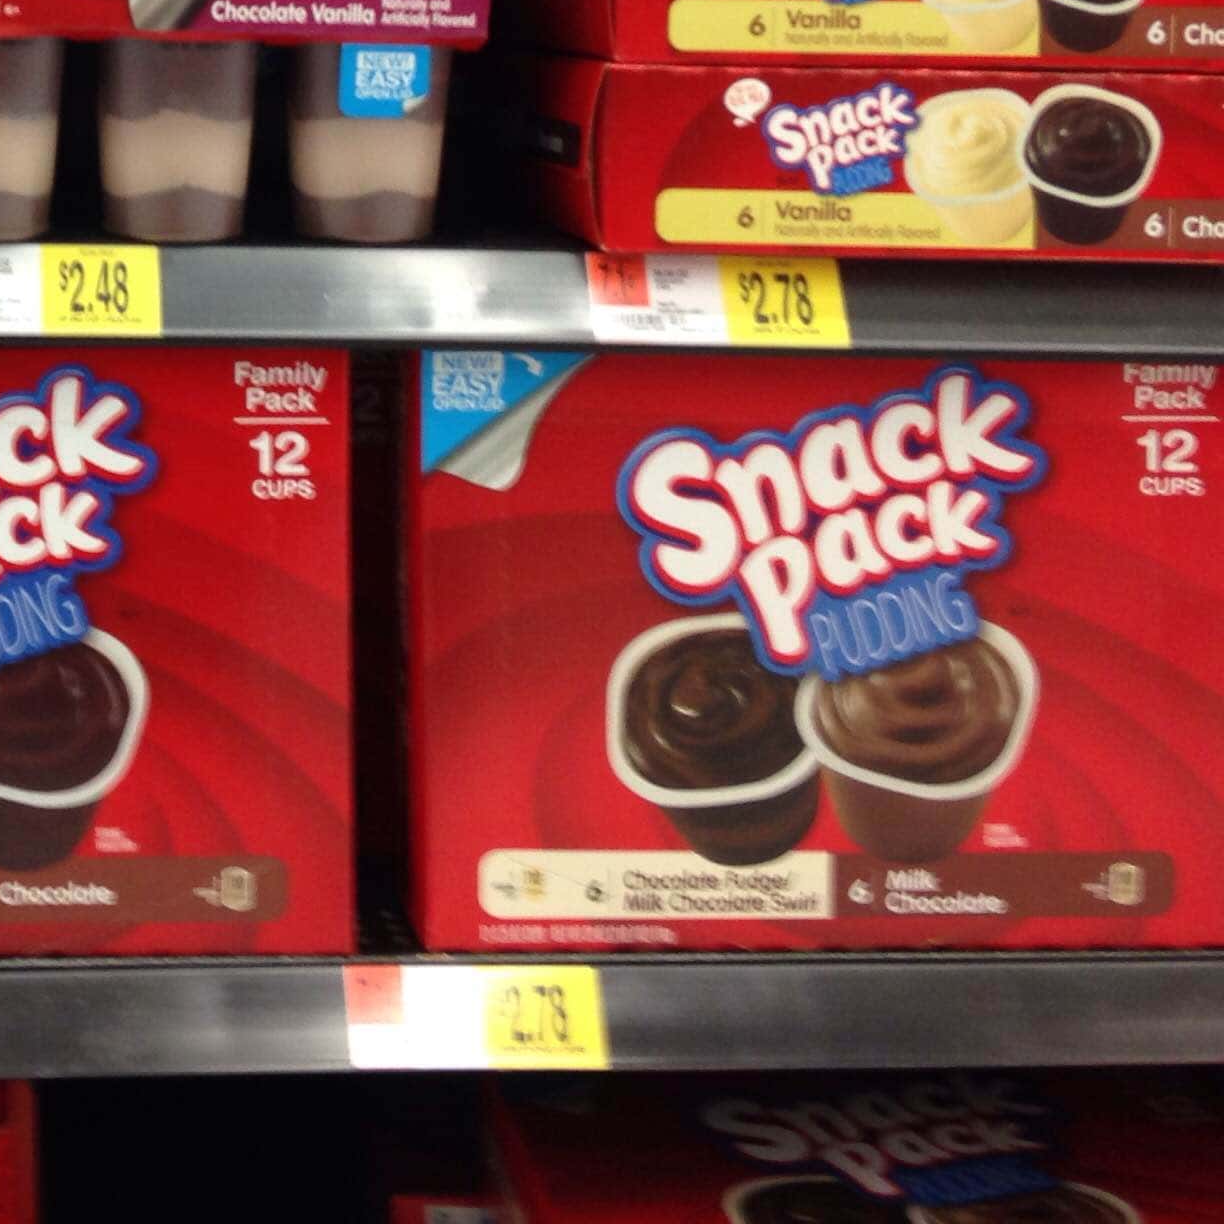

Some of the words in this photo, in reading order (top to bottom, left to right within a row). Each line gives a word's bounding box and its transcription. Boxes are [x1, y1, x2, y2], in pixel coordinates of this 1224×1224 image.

[211, 1, 306, 22] Chocolate
[312, 4, 375, 25] Vanilla
[750, 15, 765, 36] 6
[785, 10, 860, 30] Vanilla
[1147, 22, 1165, 44] 6
[356, 71, 414, 87] EASY
[769, 86, 914, 164] Snack
[738, 206, 752, 227] 6
[775, 202, 852, 222] Vanilla
[1144, 214, 1162, 237] 6
[59, 260, 129, 313] $2.48
[738, 271, 814, 325] $2.78
[235, 363, 327, 393] Family
[432, 374, 502, 398] EASY
[1123, 361, 1215, 390] Family
[246, 388, 316, 413] Pack
[1135, 386, 1205, 410] Pack
[248, 431, 311, 477] 12
[1137, 429, 1198, 473] 12
[253, 478, 316, 501] CUPS
[631, 374, 1034, 588] Snack
[1140, 475, 1204, 497] CUPS
[813, 576, 970, 679] PUDDING
[623, 870, 719, 890] Chocolate
[885, 870, 940, 890] Milk
[623, 893, 664, 911] Milk
[669, 892, 765, 913] Chocolate
[885, 892, 1008, 914] Chocolate
[708, 1073, 1047, 1164] Snack
